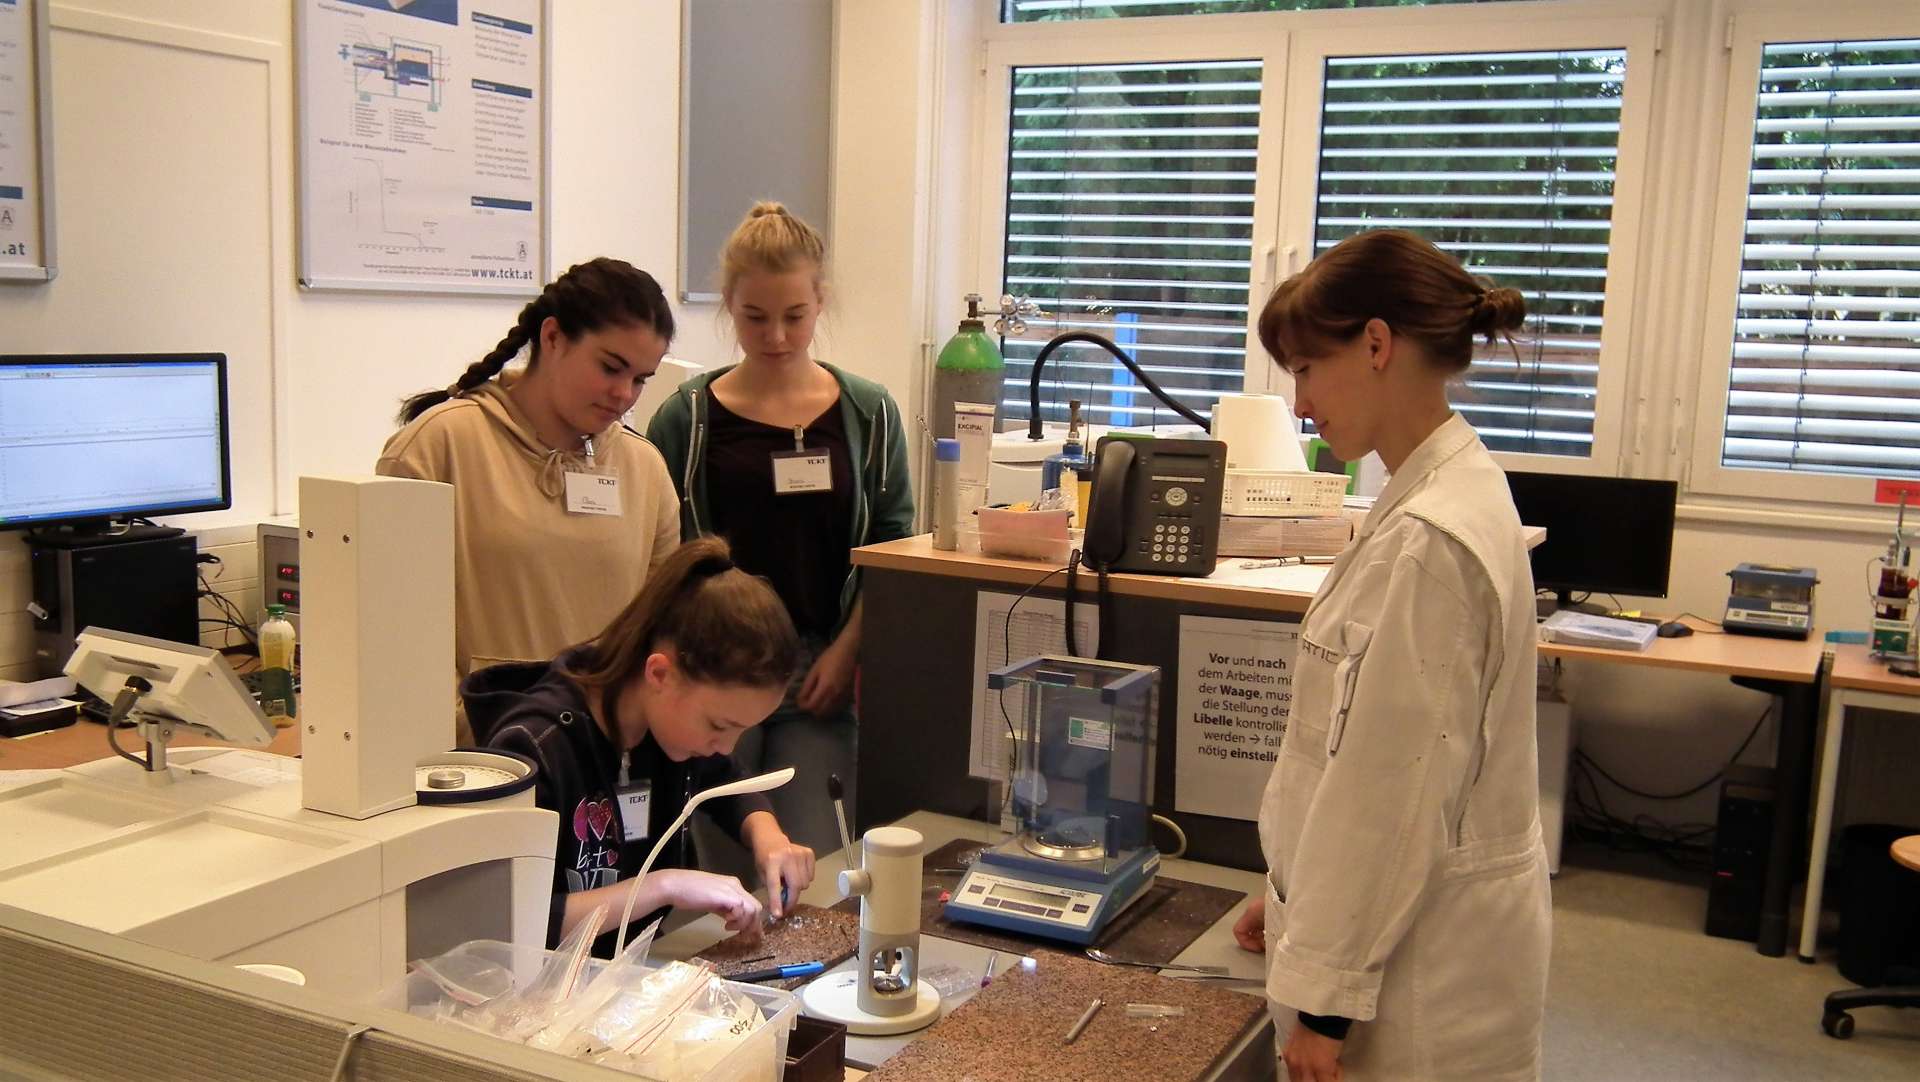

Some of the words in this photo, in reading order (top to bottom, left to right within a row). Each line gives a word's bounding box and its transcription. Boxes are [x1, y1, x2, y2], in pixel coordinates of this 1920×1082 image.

[471, 267, 533, 280] www.tckt.at
[1209, 652, 1230, 665] Vor
[1232, 655, 1254, 667] und
[1257, 658, 1286, 669] nach
[1198, 667, 1223, 679] dem
[1226, 669, 1274, 684] Arbeiten
[1198, 683, 1217, 694] der
[1220, 684, 1262, 700] Waage,
[1202, 699, 1219, 710] die
[1222, 700, 1269, 717] Stellung
[1271, 705, 1290, 717] der
[1193, 712, 1233, 727] Libelle
[1204, 730, 1246, 743] werden
[1198, 744, 1227, 760] nötig
